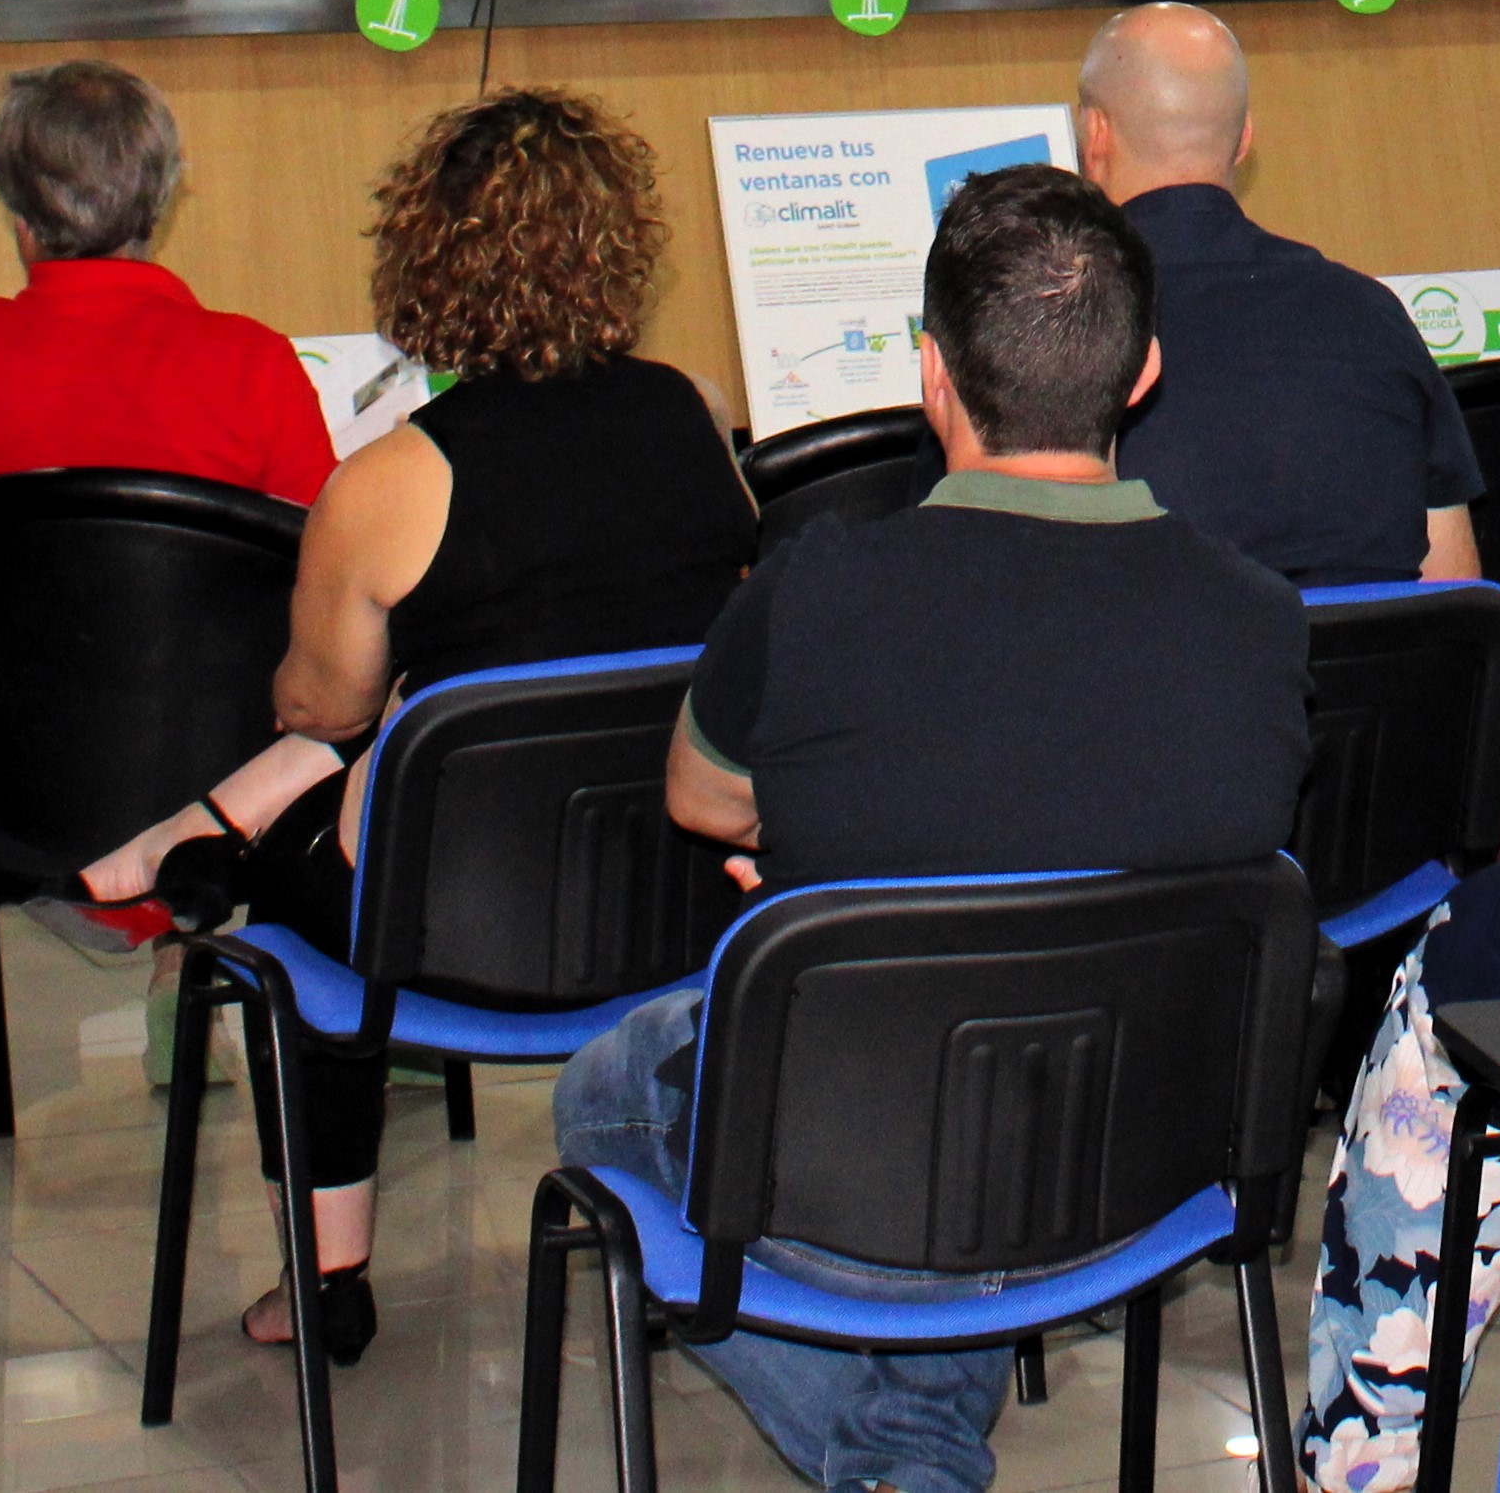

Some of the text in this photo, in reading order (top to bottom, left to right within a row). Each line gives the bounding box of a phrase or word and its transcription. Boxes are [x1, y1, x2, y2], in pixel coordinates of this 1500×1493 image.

[735, 140, 875, 164] Renueva tus
[740, 169, 890, 192] ventanas con
[778, 200, 858, 222] climalit
[1415, 306, 1457, 319] climalit
